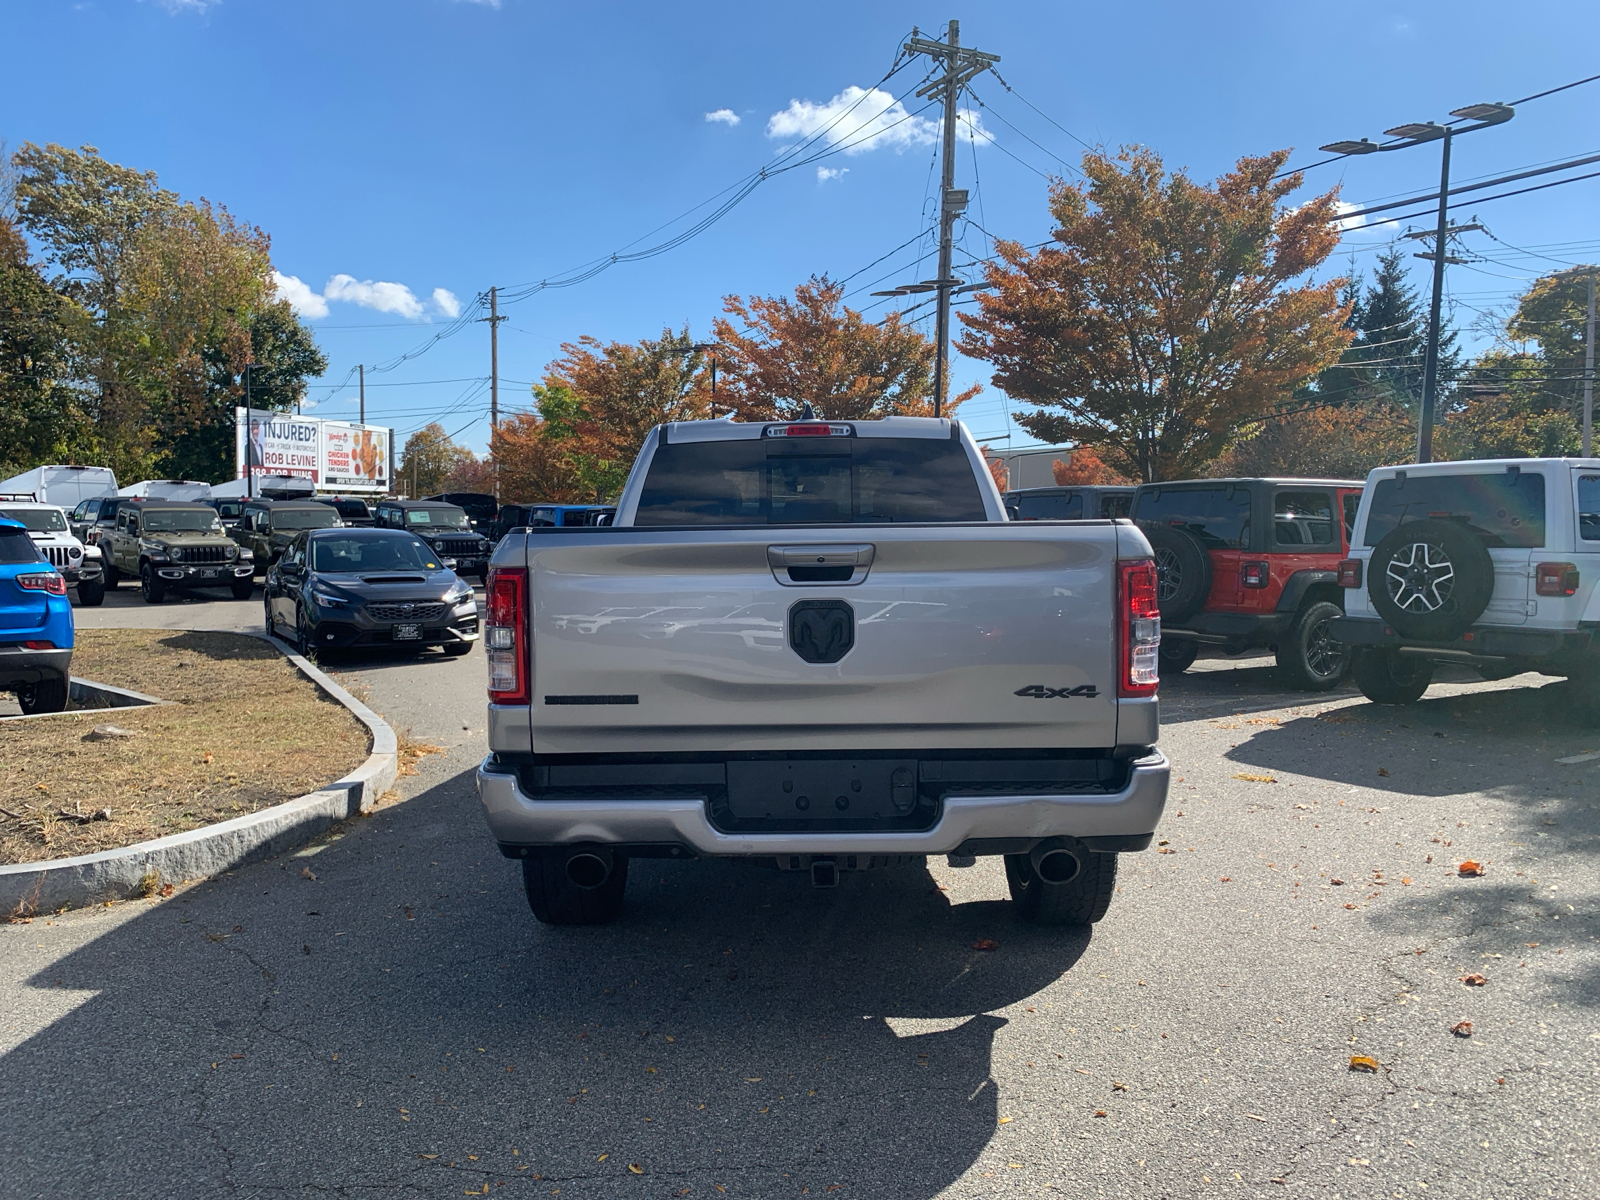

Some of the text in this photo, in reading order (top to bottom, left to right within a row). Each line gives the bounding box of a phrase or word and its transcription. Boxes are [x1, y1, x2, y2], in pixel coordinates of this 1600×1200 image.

[264, 421, 317, 442] INJURED?
[264, 452, 316, 467] ROB LEVINE
[327, 450, 349, 459] CHICKEN
[327, 458, 349, 467] TENDERS
[1013, 685, 1101, 698] 4x4
